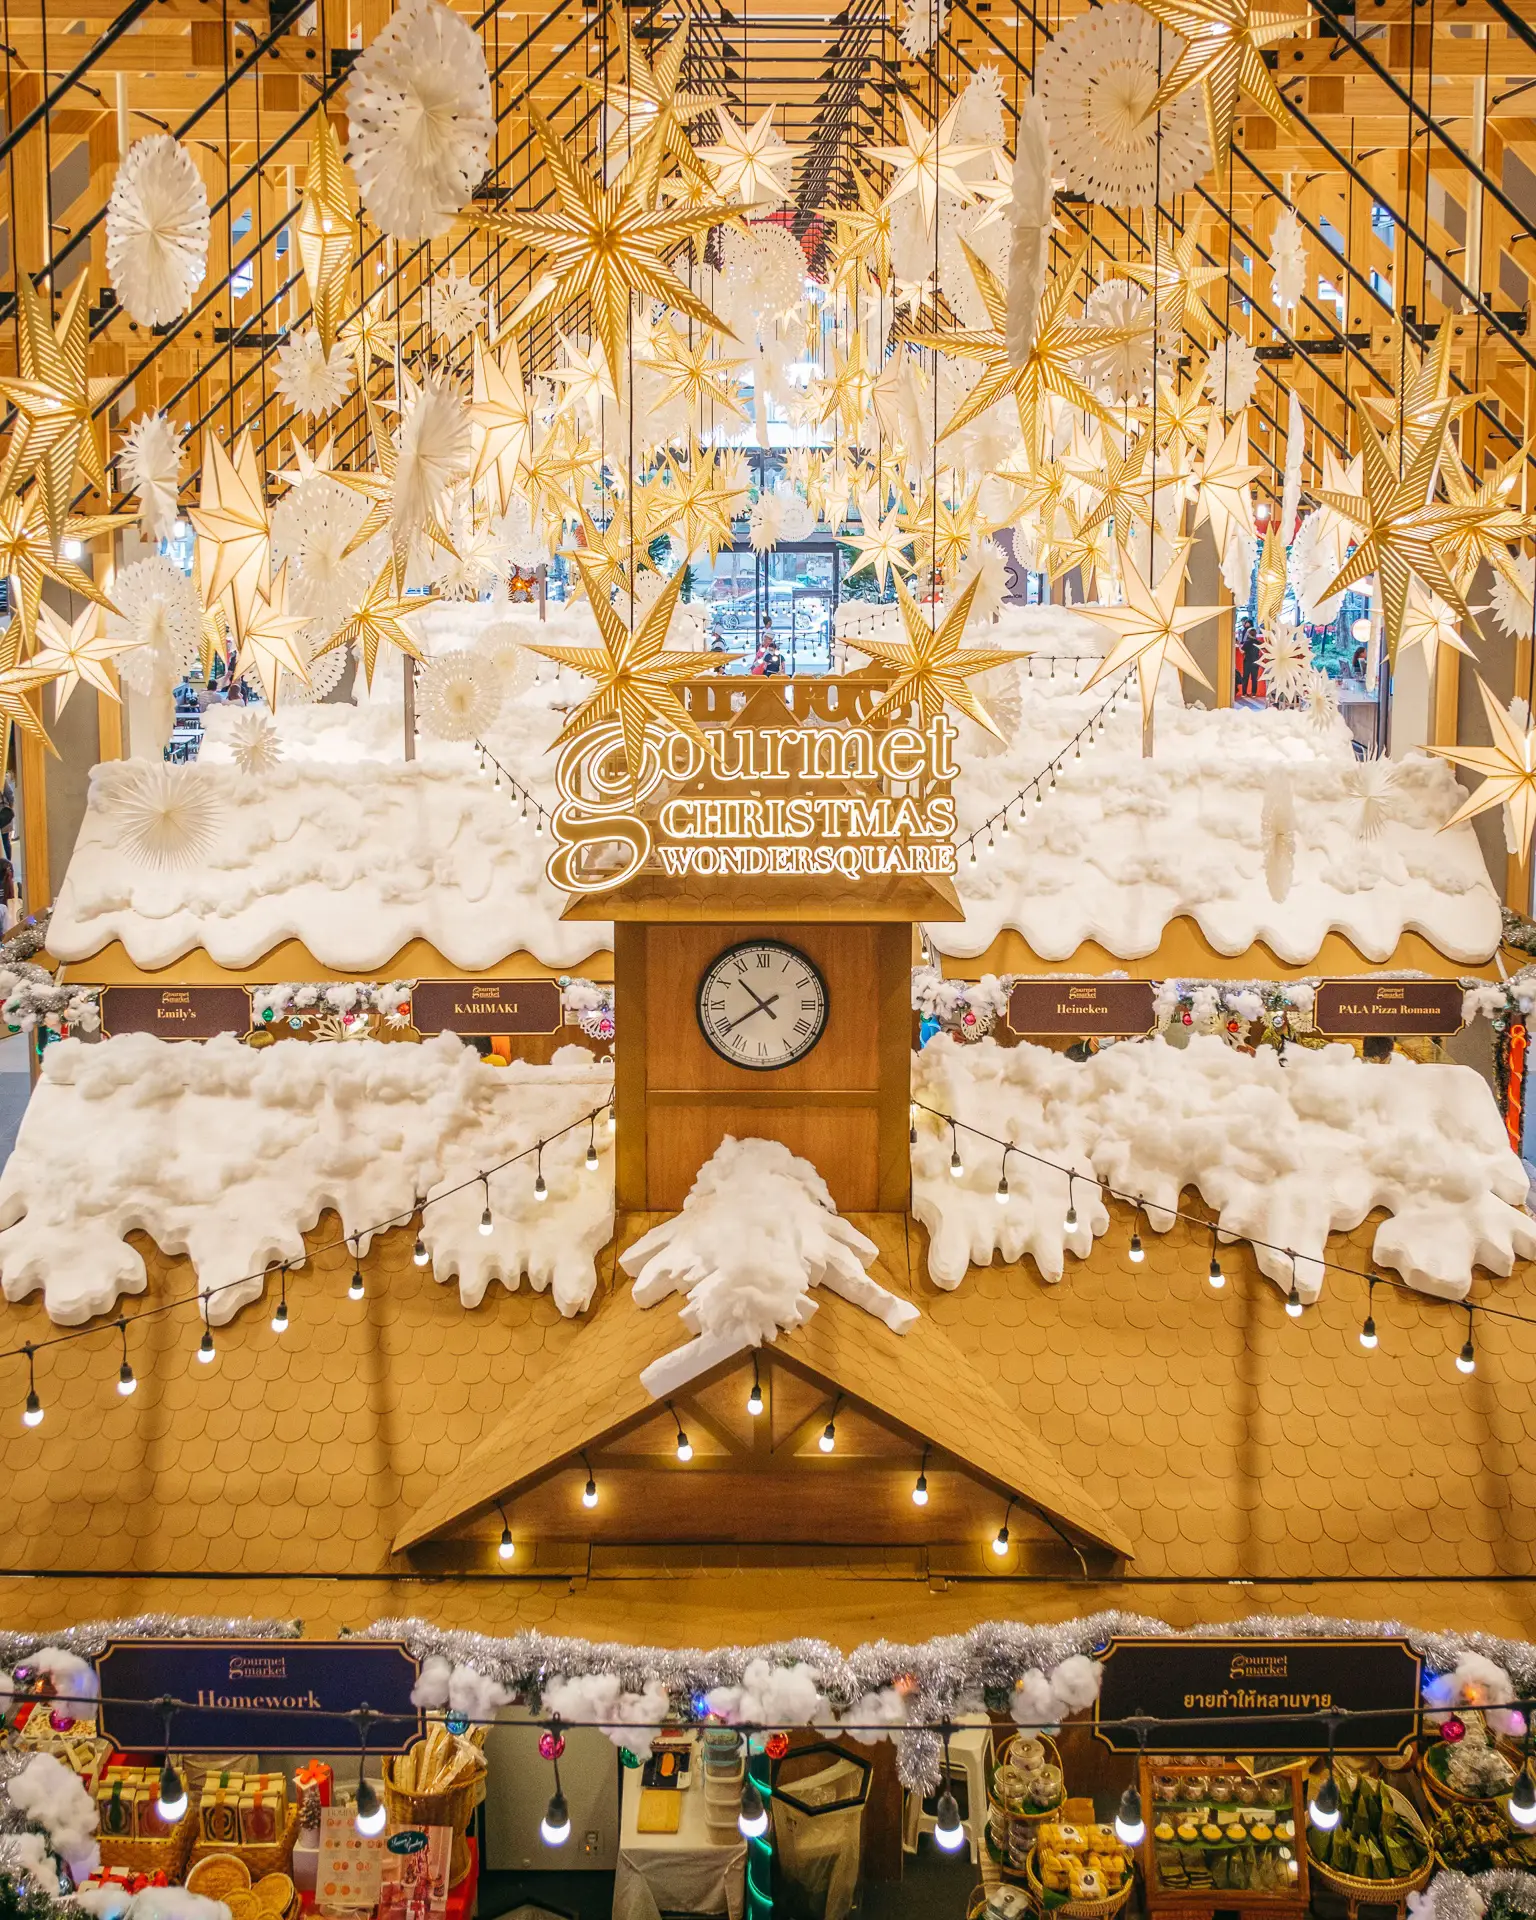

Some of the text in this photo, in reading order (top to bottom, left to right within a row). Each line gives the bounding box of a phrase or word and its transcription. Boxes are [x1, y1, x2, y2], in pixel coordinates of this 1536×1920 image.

[661, 797, 956, 839] CHRISTMAS
[657, 845, 955, 878] WONDERSQUARE
[157, 1008, 197, 1021] Emily's
[454, 1003, 519, 1014] KARIMAKI
[1057, 1004, 1108, 1014] Heineken
[1339, 1005, 1441, 1014] PALA Pizza Romana
[197, 1689, 322, 1709] Homework
[1183, 1688, 1332, 1708] ยายทำให้หลานขาย
